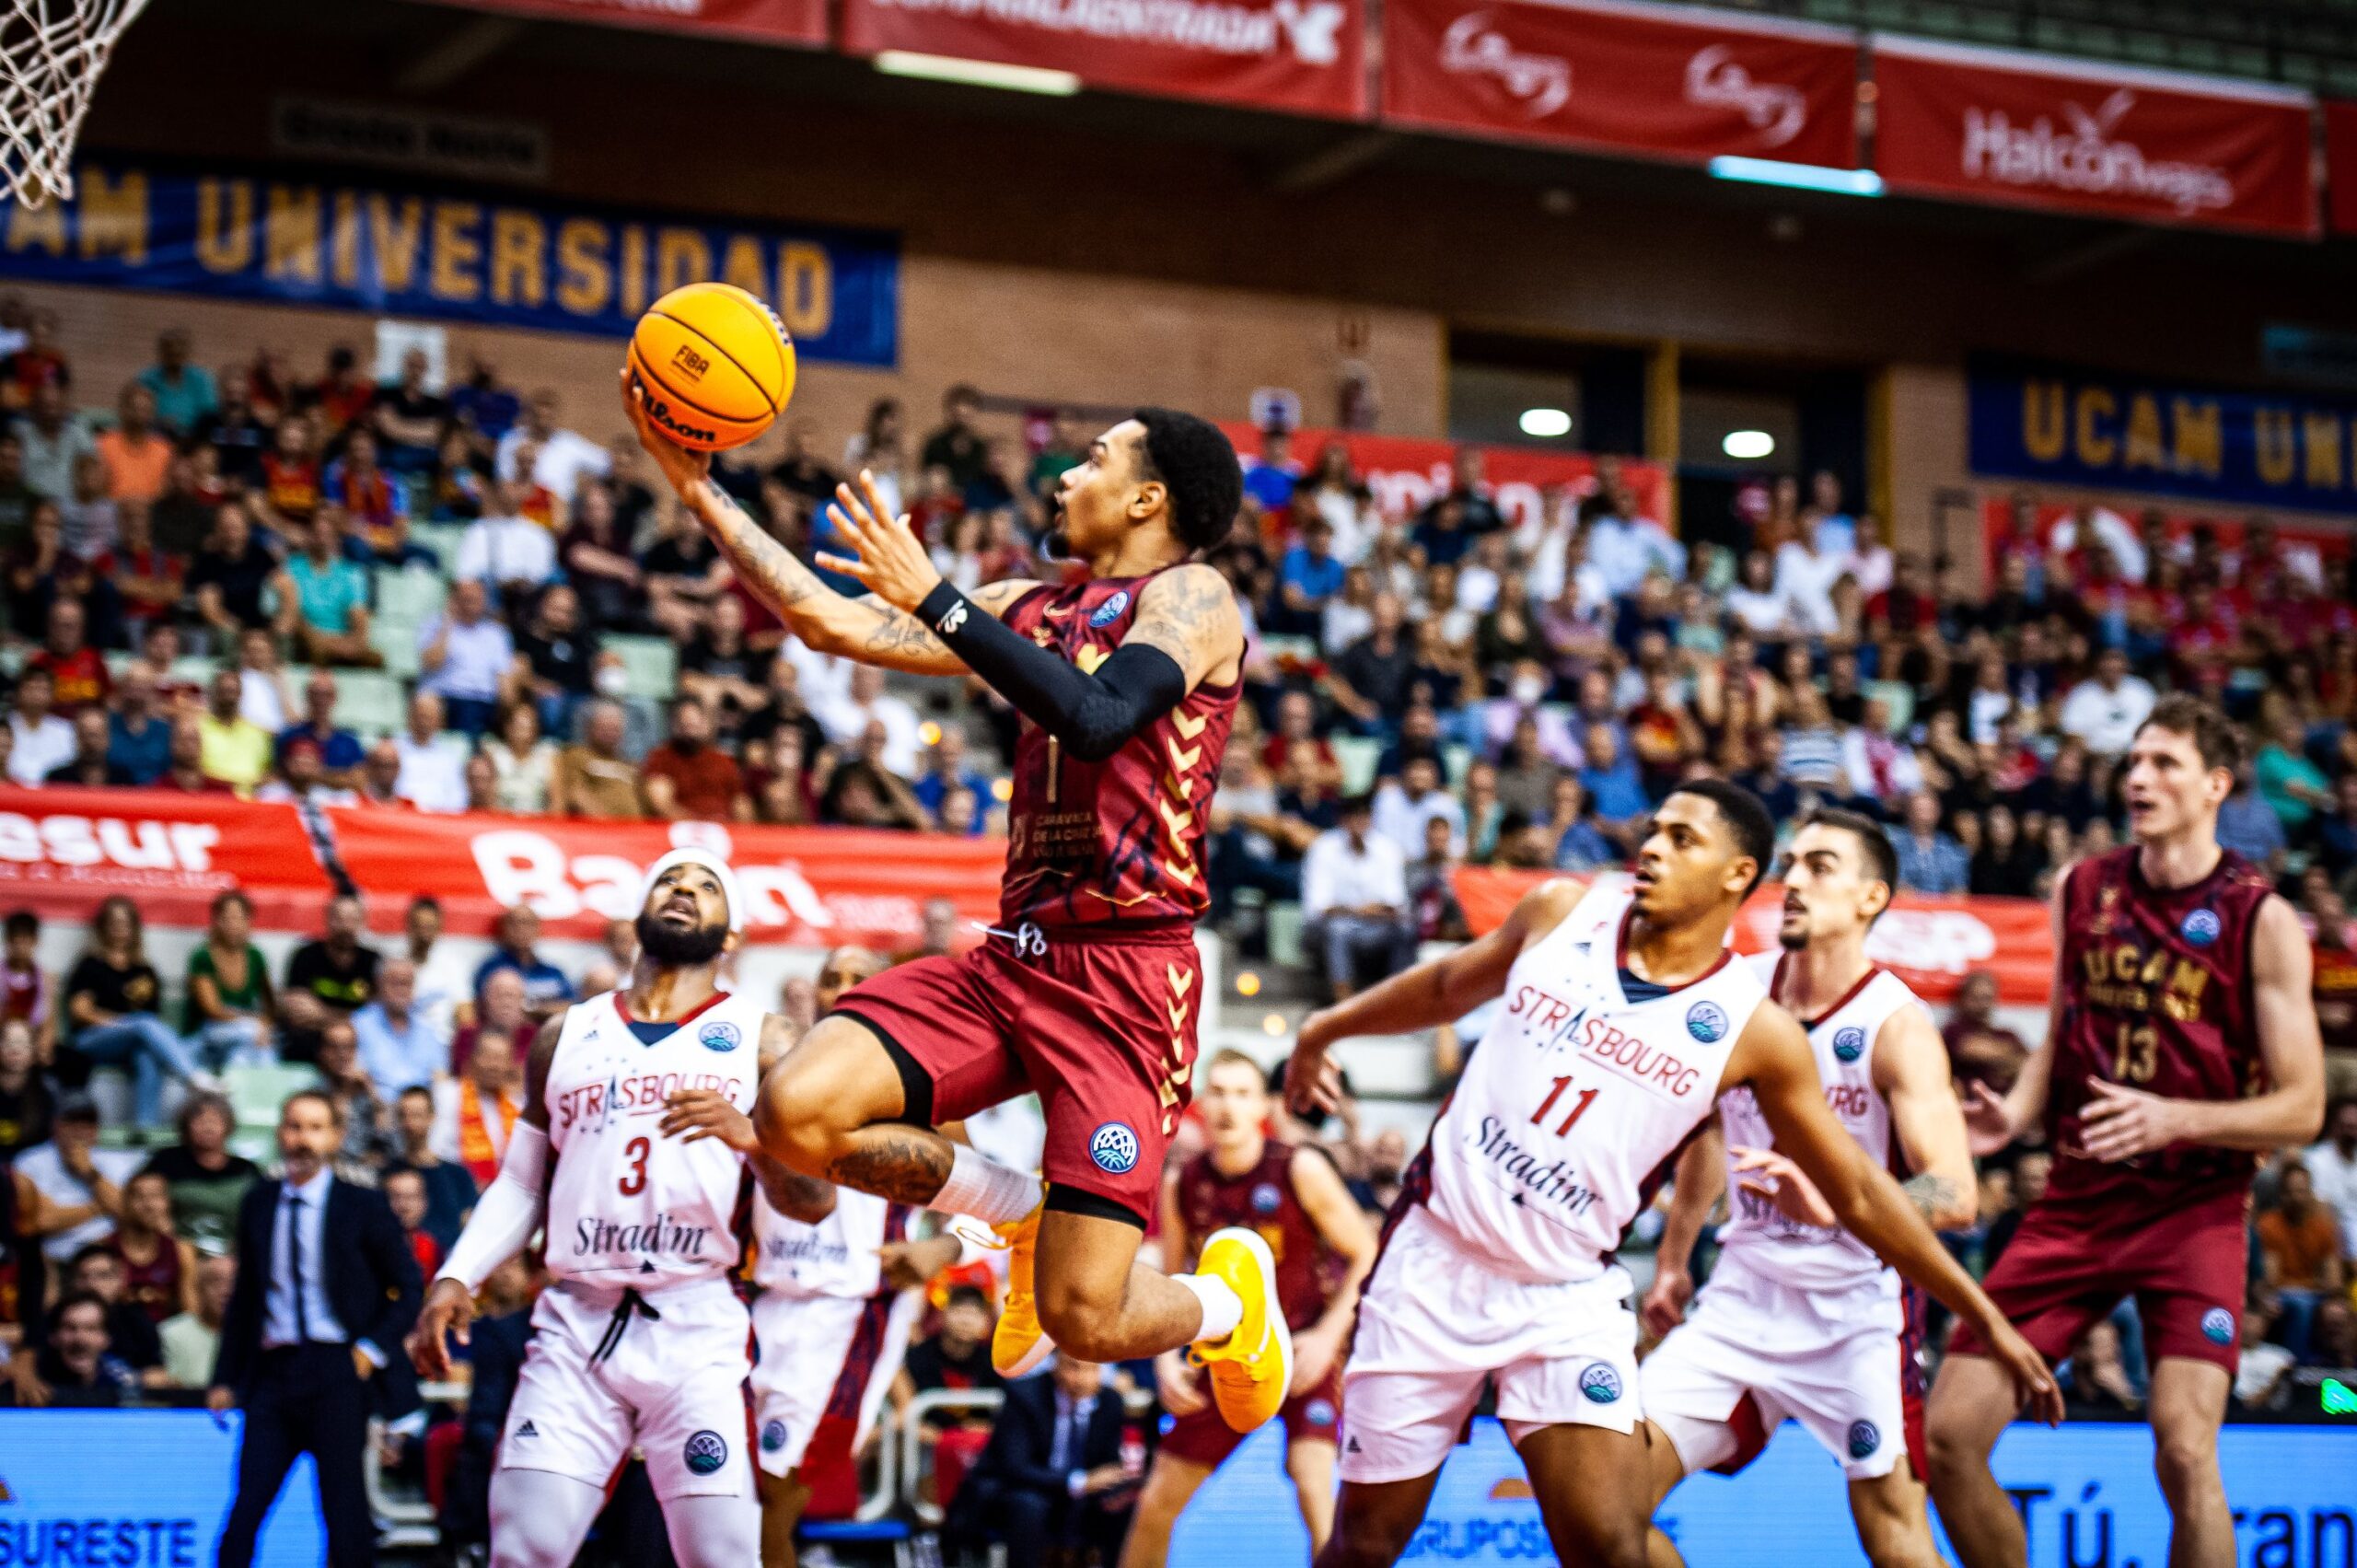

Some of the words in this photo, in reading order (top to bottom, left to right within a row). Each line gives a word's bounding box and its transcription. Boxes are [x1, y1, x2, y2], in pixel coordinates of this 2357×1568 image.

[195, 178, 832, 340] UNIVERSIDAD
[675, 343, 711, 377] FIBA
[2022, 379, 2224, 482] UCAM
[1509, 985, 1701, 1098] STRASBOURG
[2114, 1022, 2159, 1083] 13
[1530, 1074, 1600, 1138] 11
[619, 1136, 651, 1197] 3
[1475, 1116, 1604, 1215] Stradim
